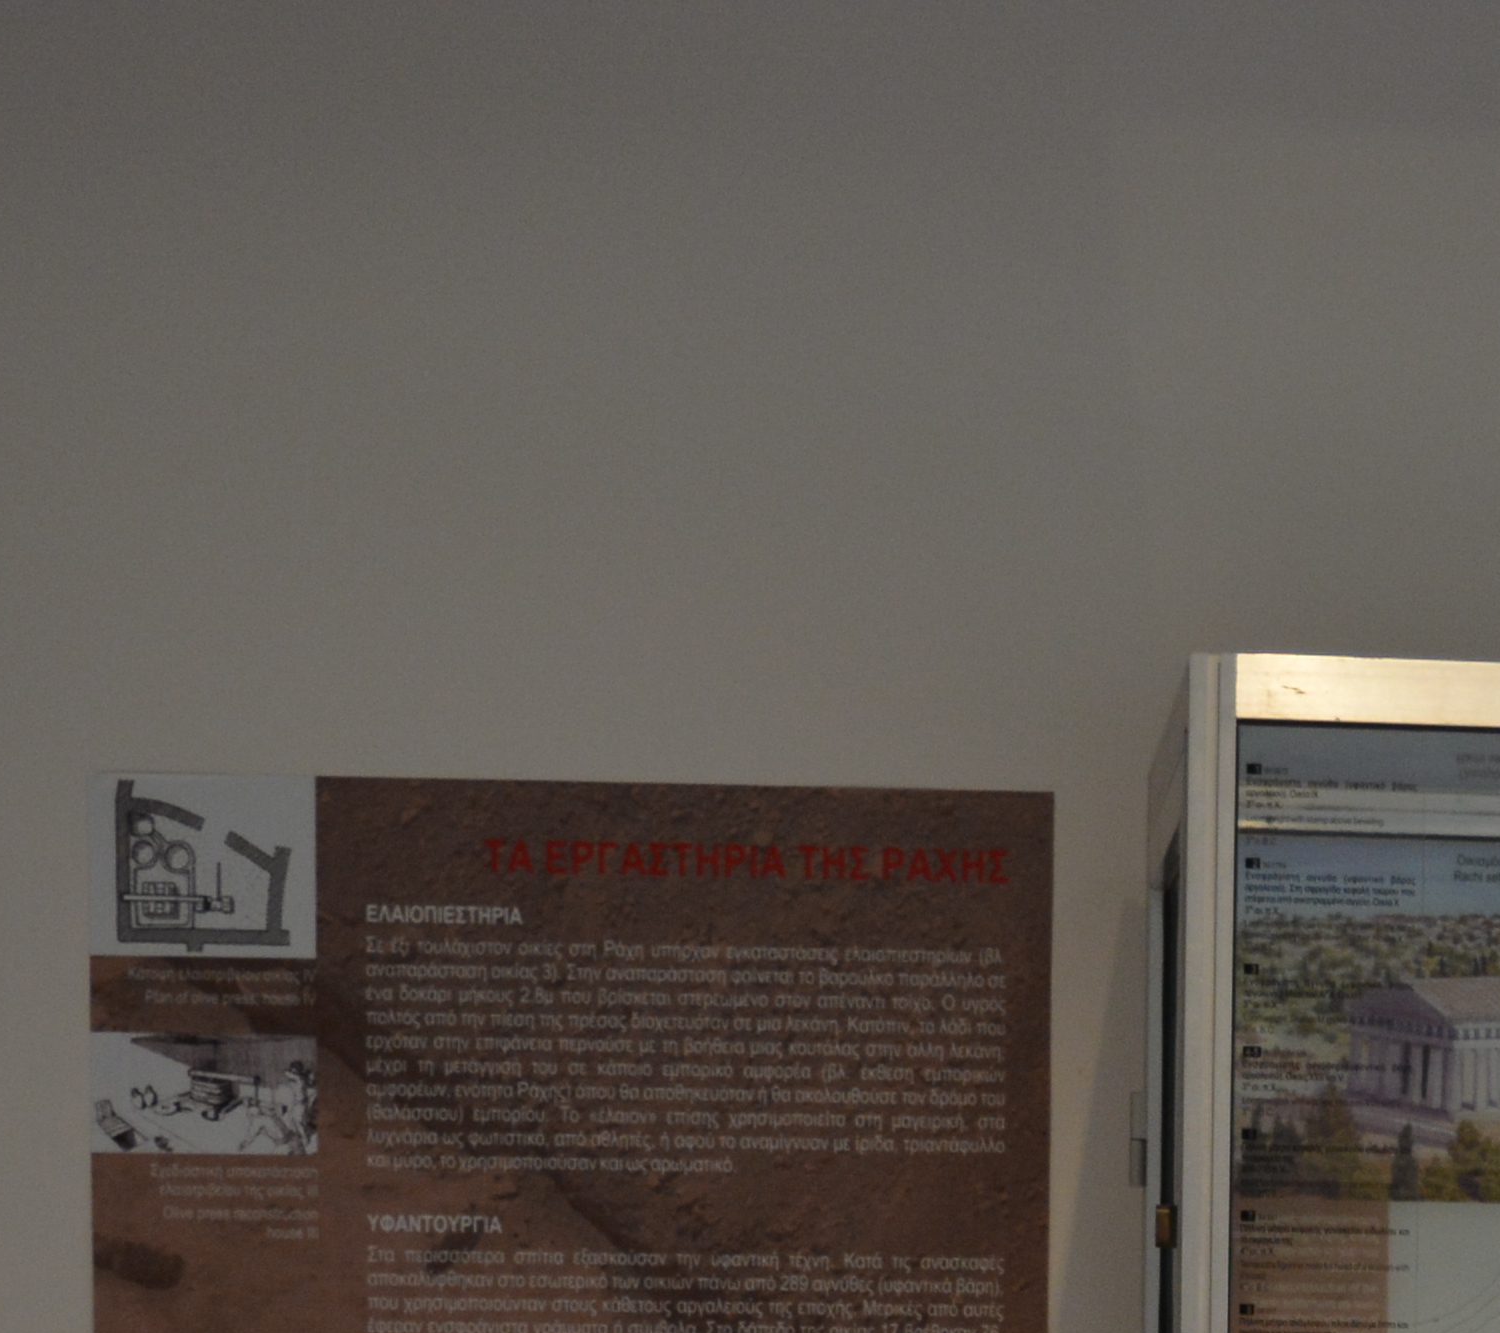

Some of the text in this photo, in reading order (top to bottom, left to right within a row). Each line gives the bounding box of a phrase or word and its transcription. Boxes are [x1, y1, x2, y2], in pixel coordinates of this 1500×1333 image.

[484, 838, 1009, 884] ΤΑ ΕΡΓΑΣΤΗΡΙΑ ΤΗΣ ΡΑΧΗΣ
[365, 904, 523, 924] ΕΛΑΙΟΠΙΕΣΤΗΡΙΑ
[366, 1214, 503, 1233] ΥΦΑΝΤΟΥΡΓΙΑ
